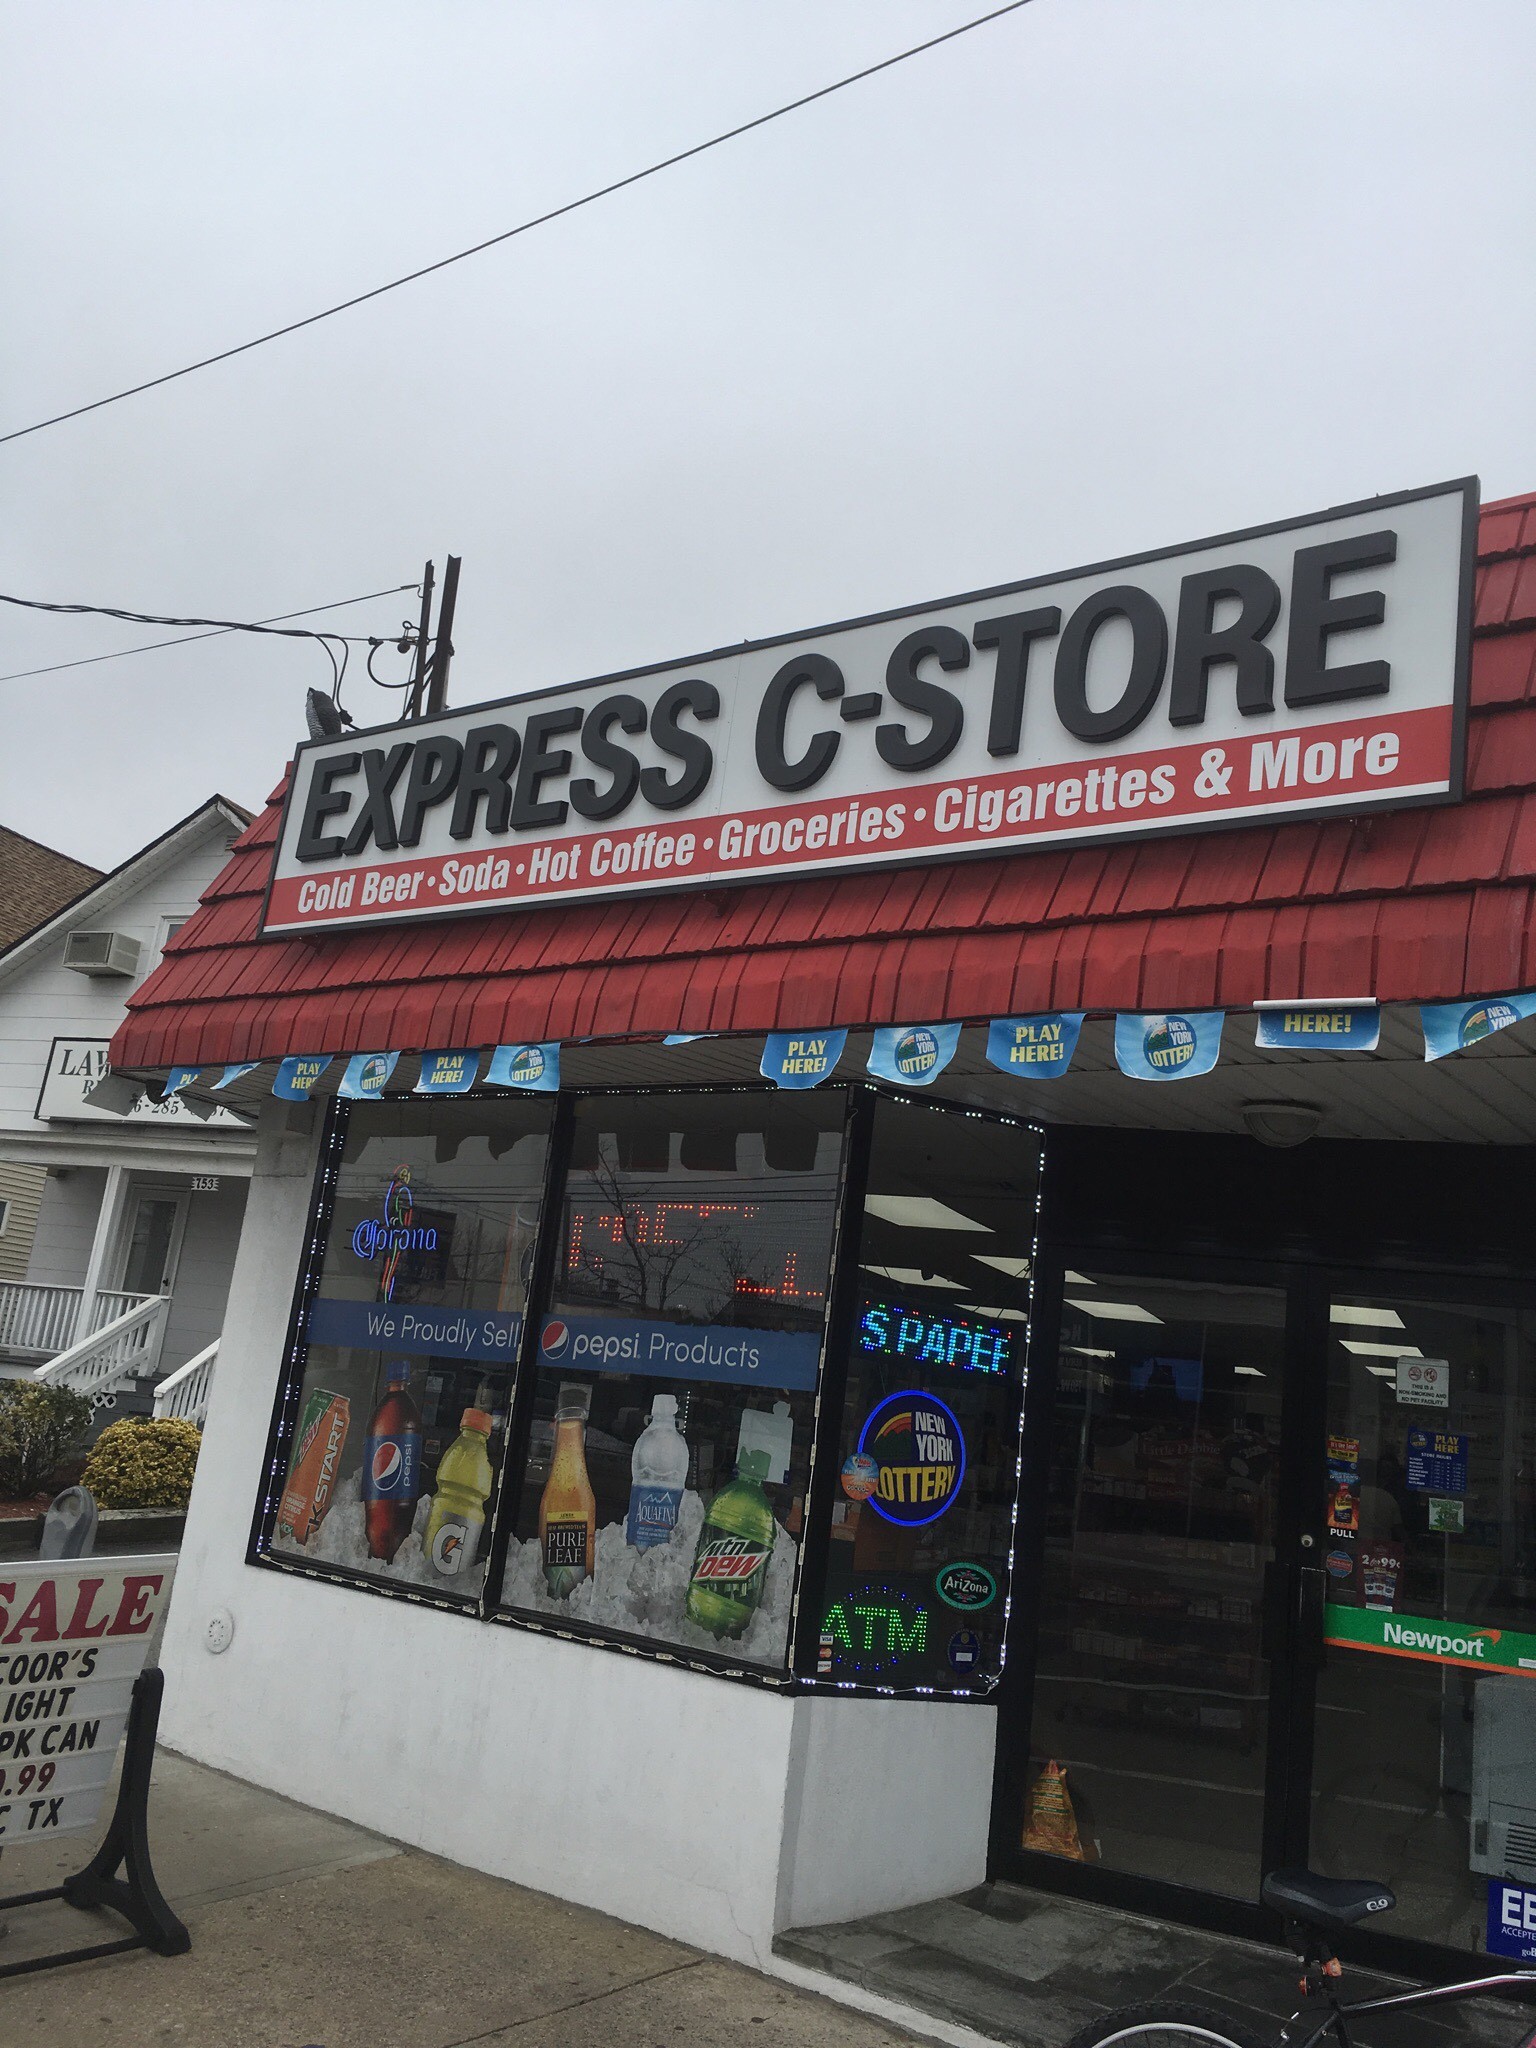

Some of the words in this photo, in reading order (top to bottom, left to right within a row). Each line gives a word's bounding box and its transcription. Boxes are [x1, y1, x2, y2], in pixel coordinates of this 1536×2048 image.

[295, 679, 720, 863] EXPRESS
[755, 529, 1398, 793] C-STORE
[297, 873, 353, 914] Cold
[360, 865, 425, 906] Beer
[438, 855, 511, 896] Soda
[527, 845, 581, 886] Hot
[589, 827, 696, 877] Coffee
[718, 800, 906, 861] Groceries
[934, 764, 1176, 834] Cigarettes
[1192, 748, 1234, 798] &
[1248, 731, 1401, 794] More
[1487, 1006, 1511, 1018] NEW
[1015, 1023, 1062, 1044] PLAY
[1168, 1021, 1188, 1032] NEW
[1283, 1013, 1352, 1034] HERE!
[915, 1032, 931, 1042] NEW
[916, 1041, 936, 1054] YORK
[1170, 1031, 1193, 1045] YORK
[788, 1040, 828, 1057] PLAY
[1010, 1042, 1065, 1063] HERE!
[1148, 1043, 1195, 1068] LOTTERY
[296, 1062, 321, 1075] PLAY
[436, 1056, 465, 1069] PLAY
[781, 1057, 827, 1075] HERE!
[898, 1052, 937, 1073] LOTTERY
[291, 1076, 317, 1089] HER
[430, 1070, 464, 1084] HERE!
[196, 1177, 214, 1190] 753
[352, 1219, 437, 1261] Corona
[367, 1312, 396, 1337] We
[401, 1316, 477, 1350] Proudly
[482, 1321, 521, 1349] Sell
[573, 1332, 640, 1361] pepsi
[649, 1333, 760, 1370] Products
[914, 1411, 946, 1435] NEW
[916, 1433, 953, 1462] YORK
[1434, 1443, 1460, 1454] HERE
[1435, 1434, 1459, 1446] PLAY
[403, 1443, 413, 1487] pepsi
[634, 1501, 676, 1526] AQUAFINA
[547, 1531, 586, 1548] PURE
[1330, 1528, 1355, 1539] PULL
[432, 1523, 469, 1575] G
[547, 1548, 582, 1563] LEAF
[820, 1604, 928, 1653] ATM
[1383, 1622, 1485, 1658] Newport
[40, 1719, 101, 1756] CAN
[0, 1762, 56, 1796] .99
[27, 1796, 64, 1831] TX
